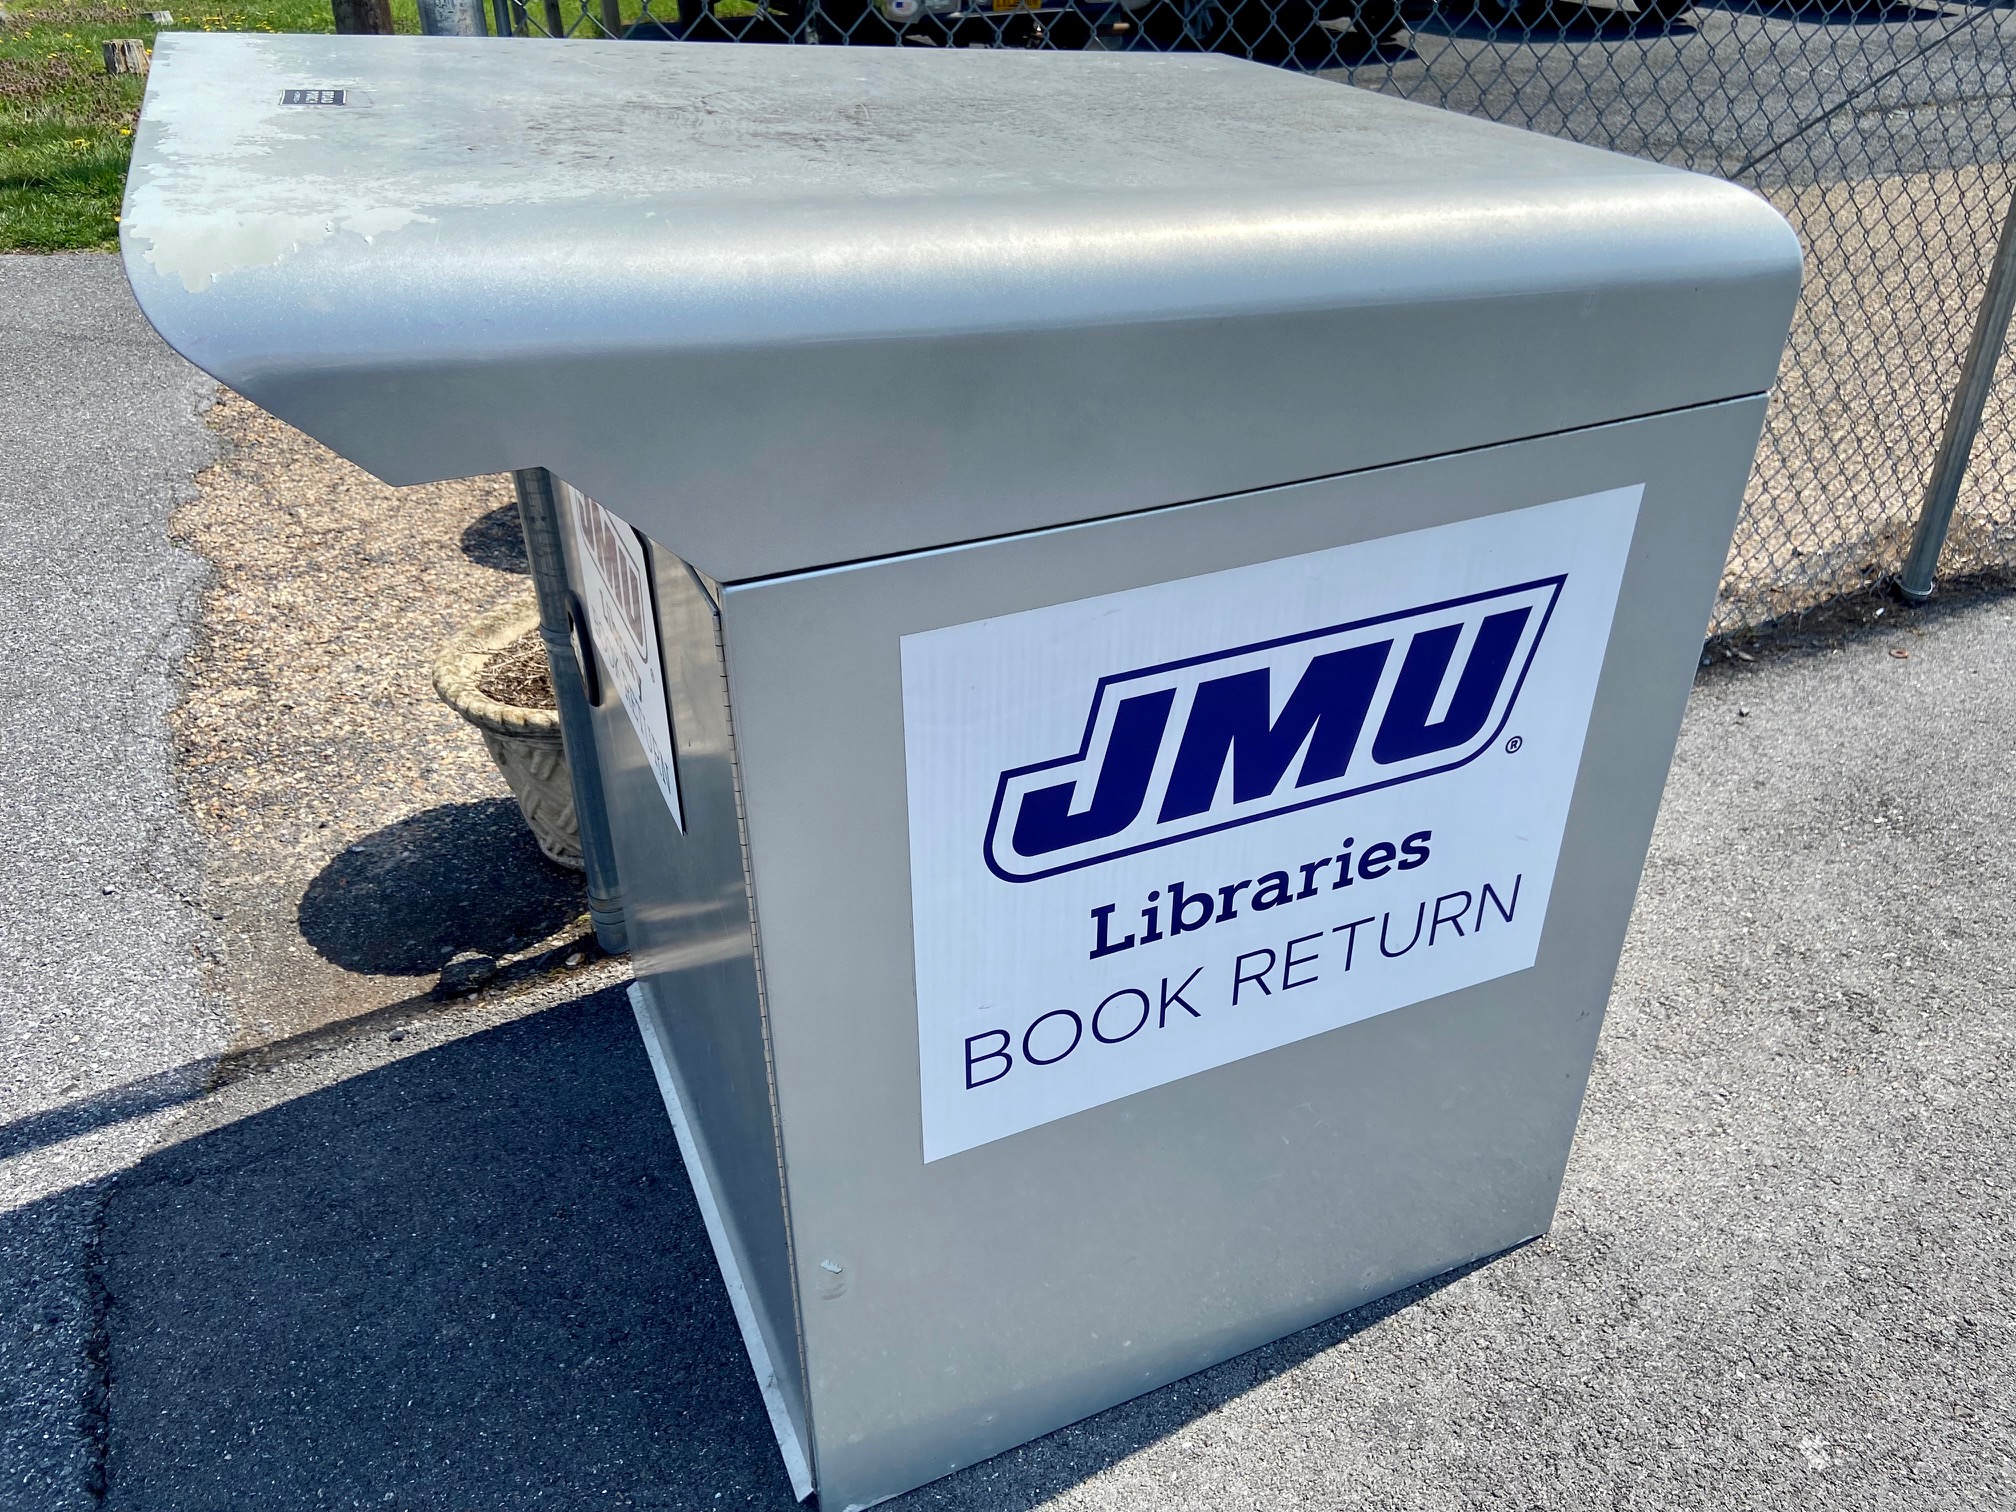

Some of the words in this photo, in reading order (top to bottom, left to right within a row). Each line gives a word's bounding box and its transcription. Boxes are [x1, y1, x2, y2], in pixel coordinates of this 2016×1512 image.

[578, 493, 643, 647] JMU
[621, 667, 671, 795] RETURN
[1011, 605, 1534, 858] JMU
[1089, 830, 1433, 960] Libraries
[965, 966, 1204, 1091] BOOK
[1231, 873, 1523, 1007] RETURN
